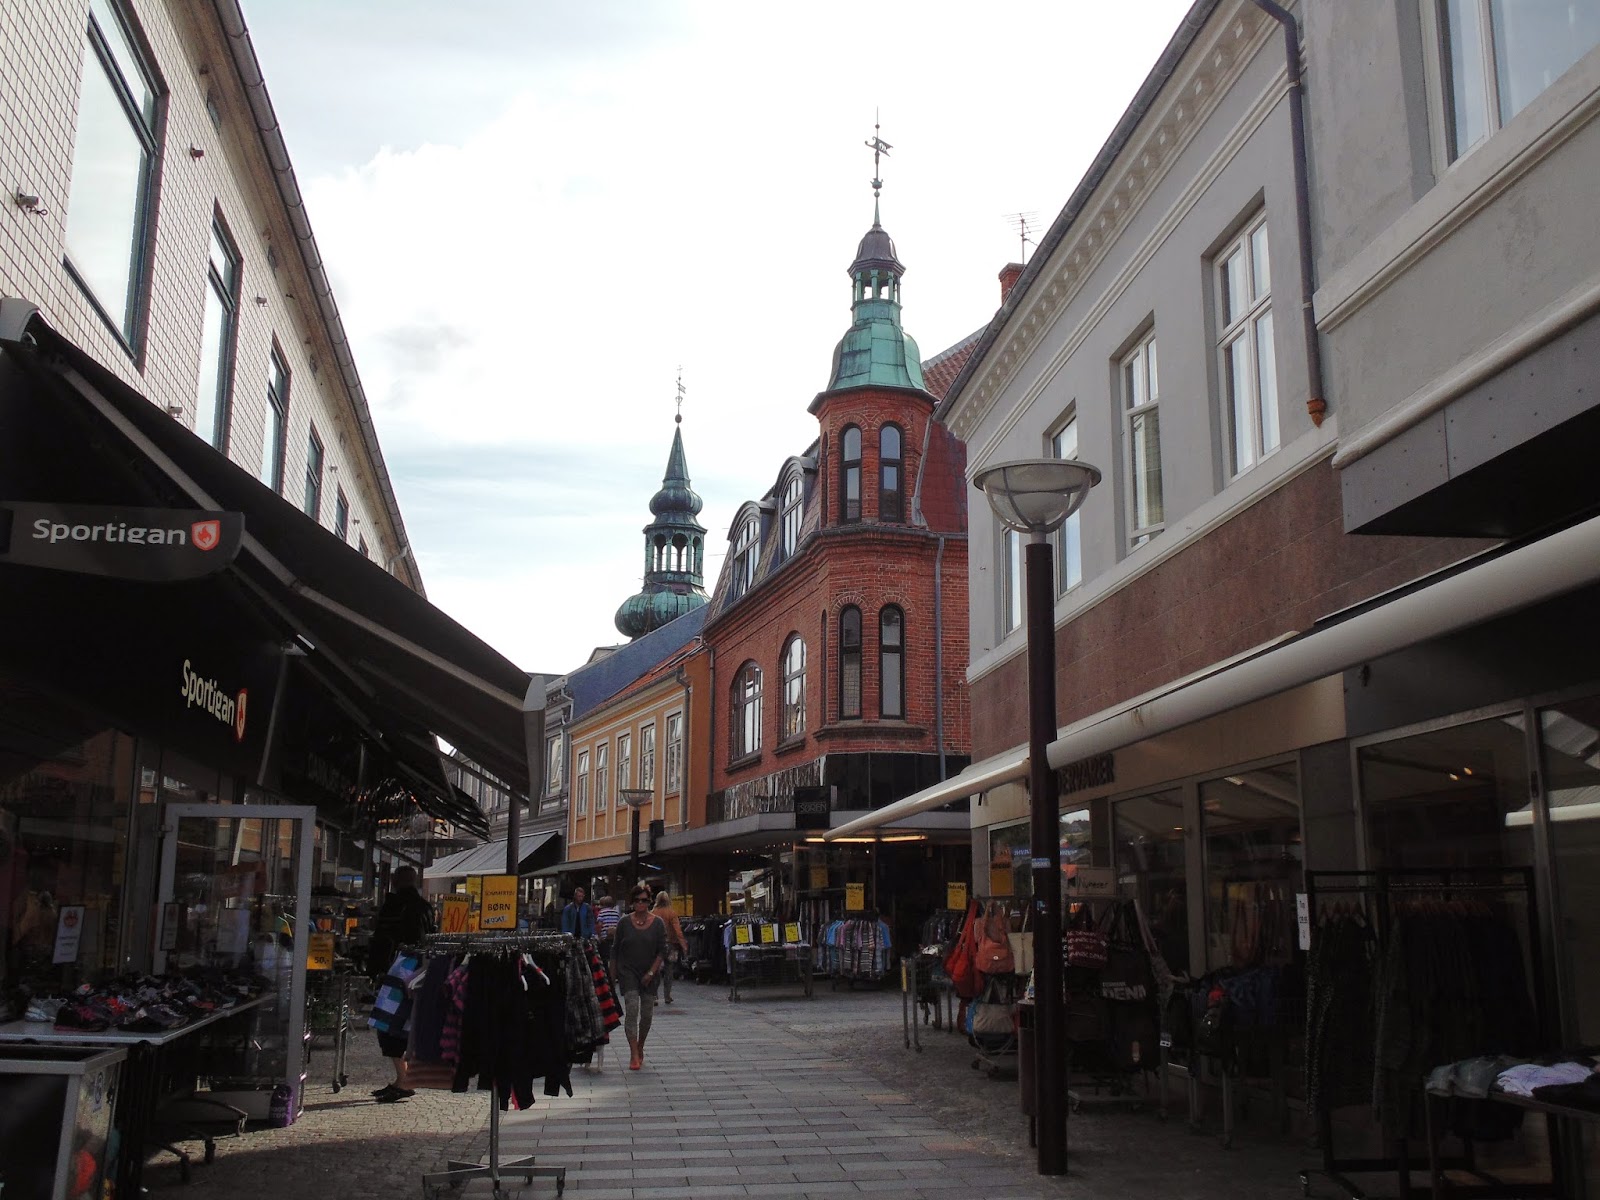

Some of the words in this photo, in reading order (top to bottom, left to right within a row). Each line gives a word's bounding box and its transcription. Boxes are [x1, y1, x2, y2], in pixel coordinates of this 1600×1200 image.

[32, 518, 187, 546] Sportigan
[181, 658, 236, 727] Sportigan
[487, 903, 511, 911] BØRN
